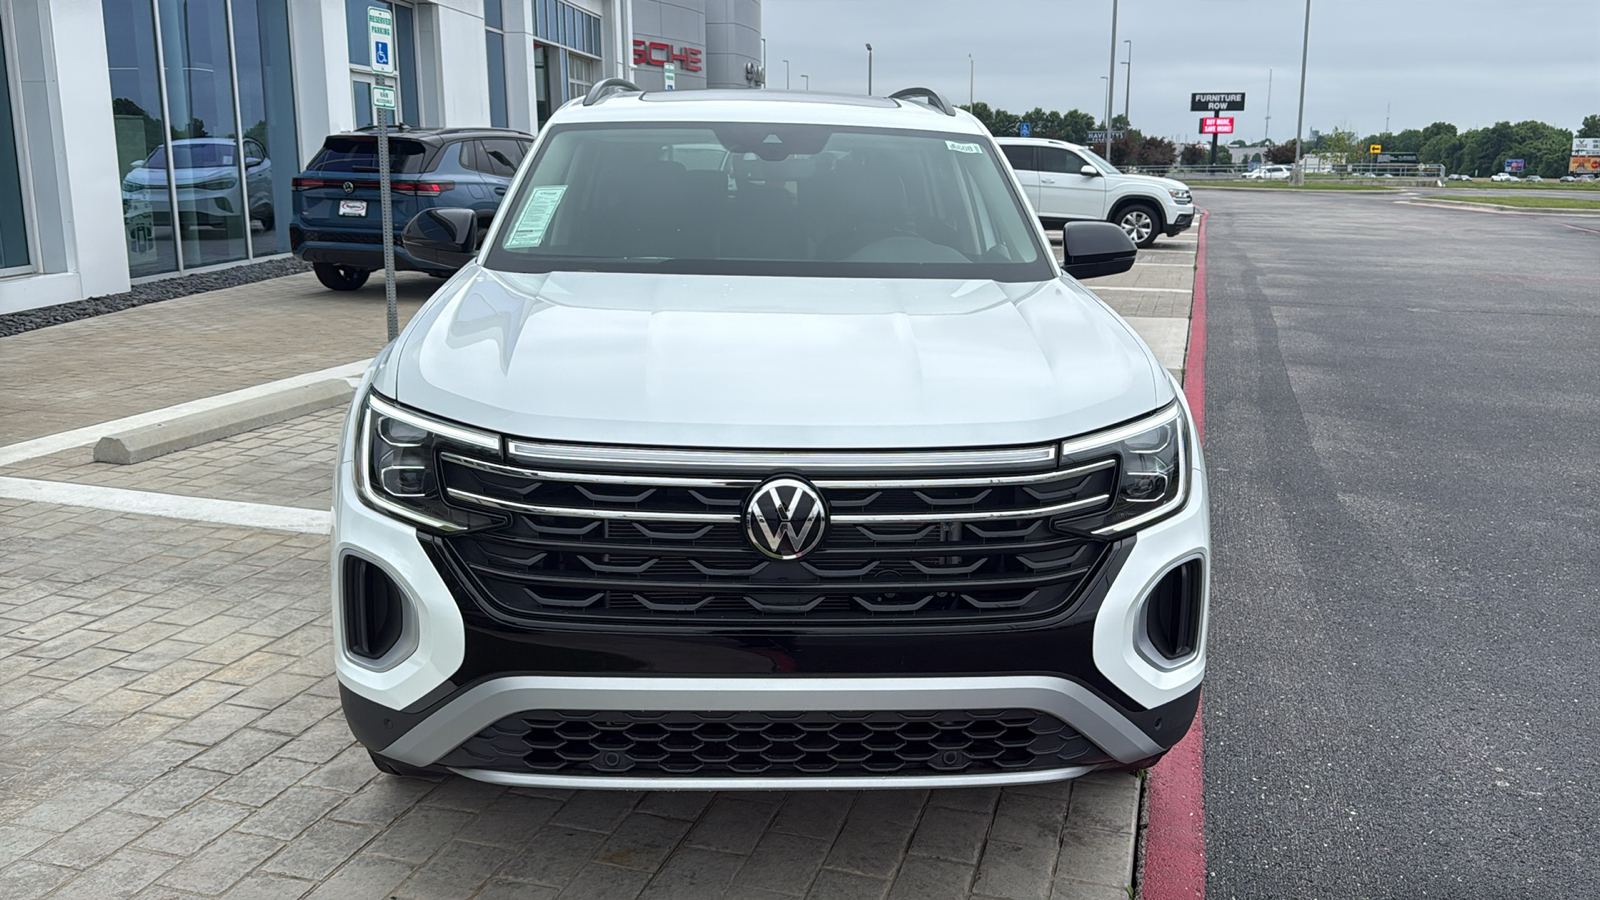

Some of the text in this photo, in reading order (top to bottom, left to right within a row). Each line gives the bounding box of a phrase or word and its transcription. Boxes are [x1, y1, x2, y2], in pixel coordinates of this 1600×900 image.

[369, 15, 391, 25] RESERVED
[371, 25, 390, 36] PARKING
[1195, 94, 1242, 102] FURNITURE
[1208, 102, 1228, 110] ROW
[747, 479, 825, 560] VW
